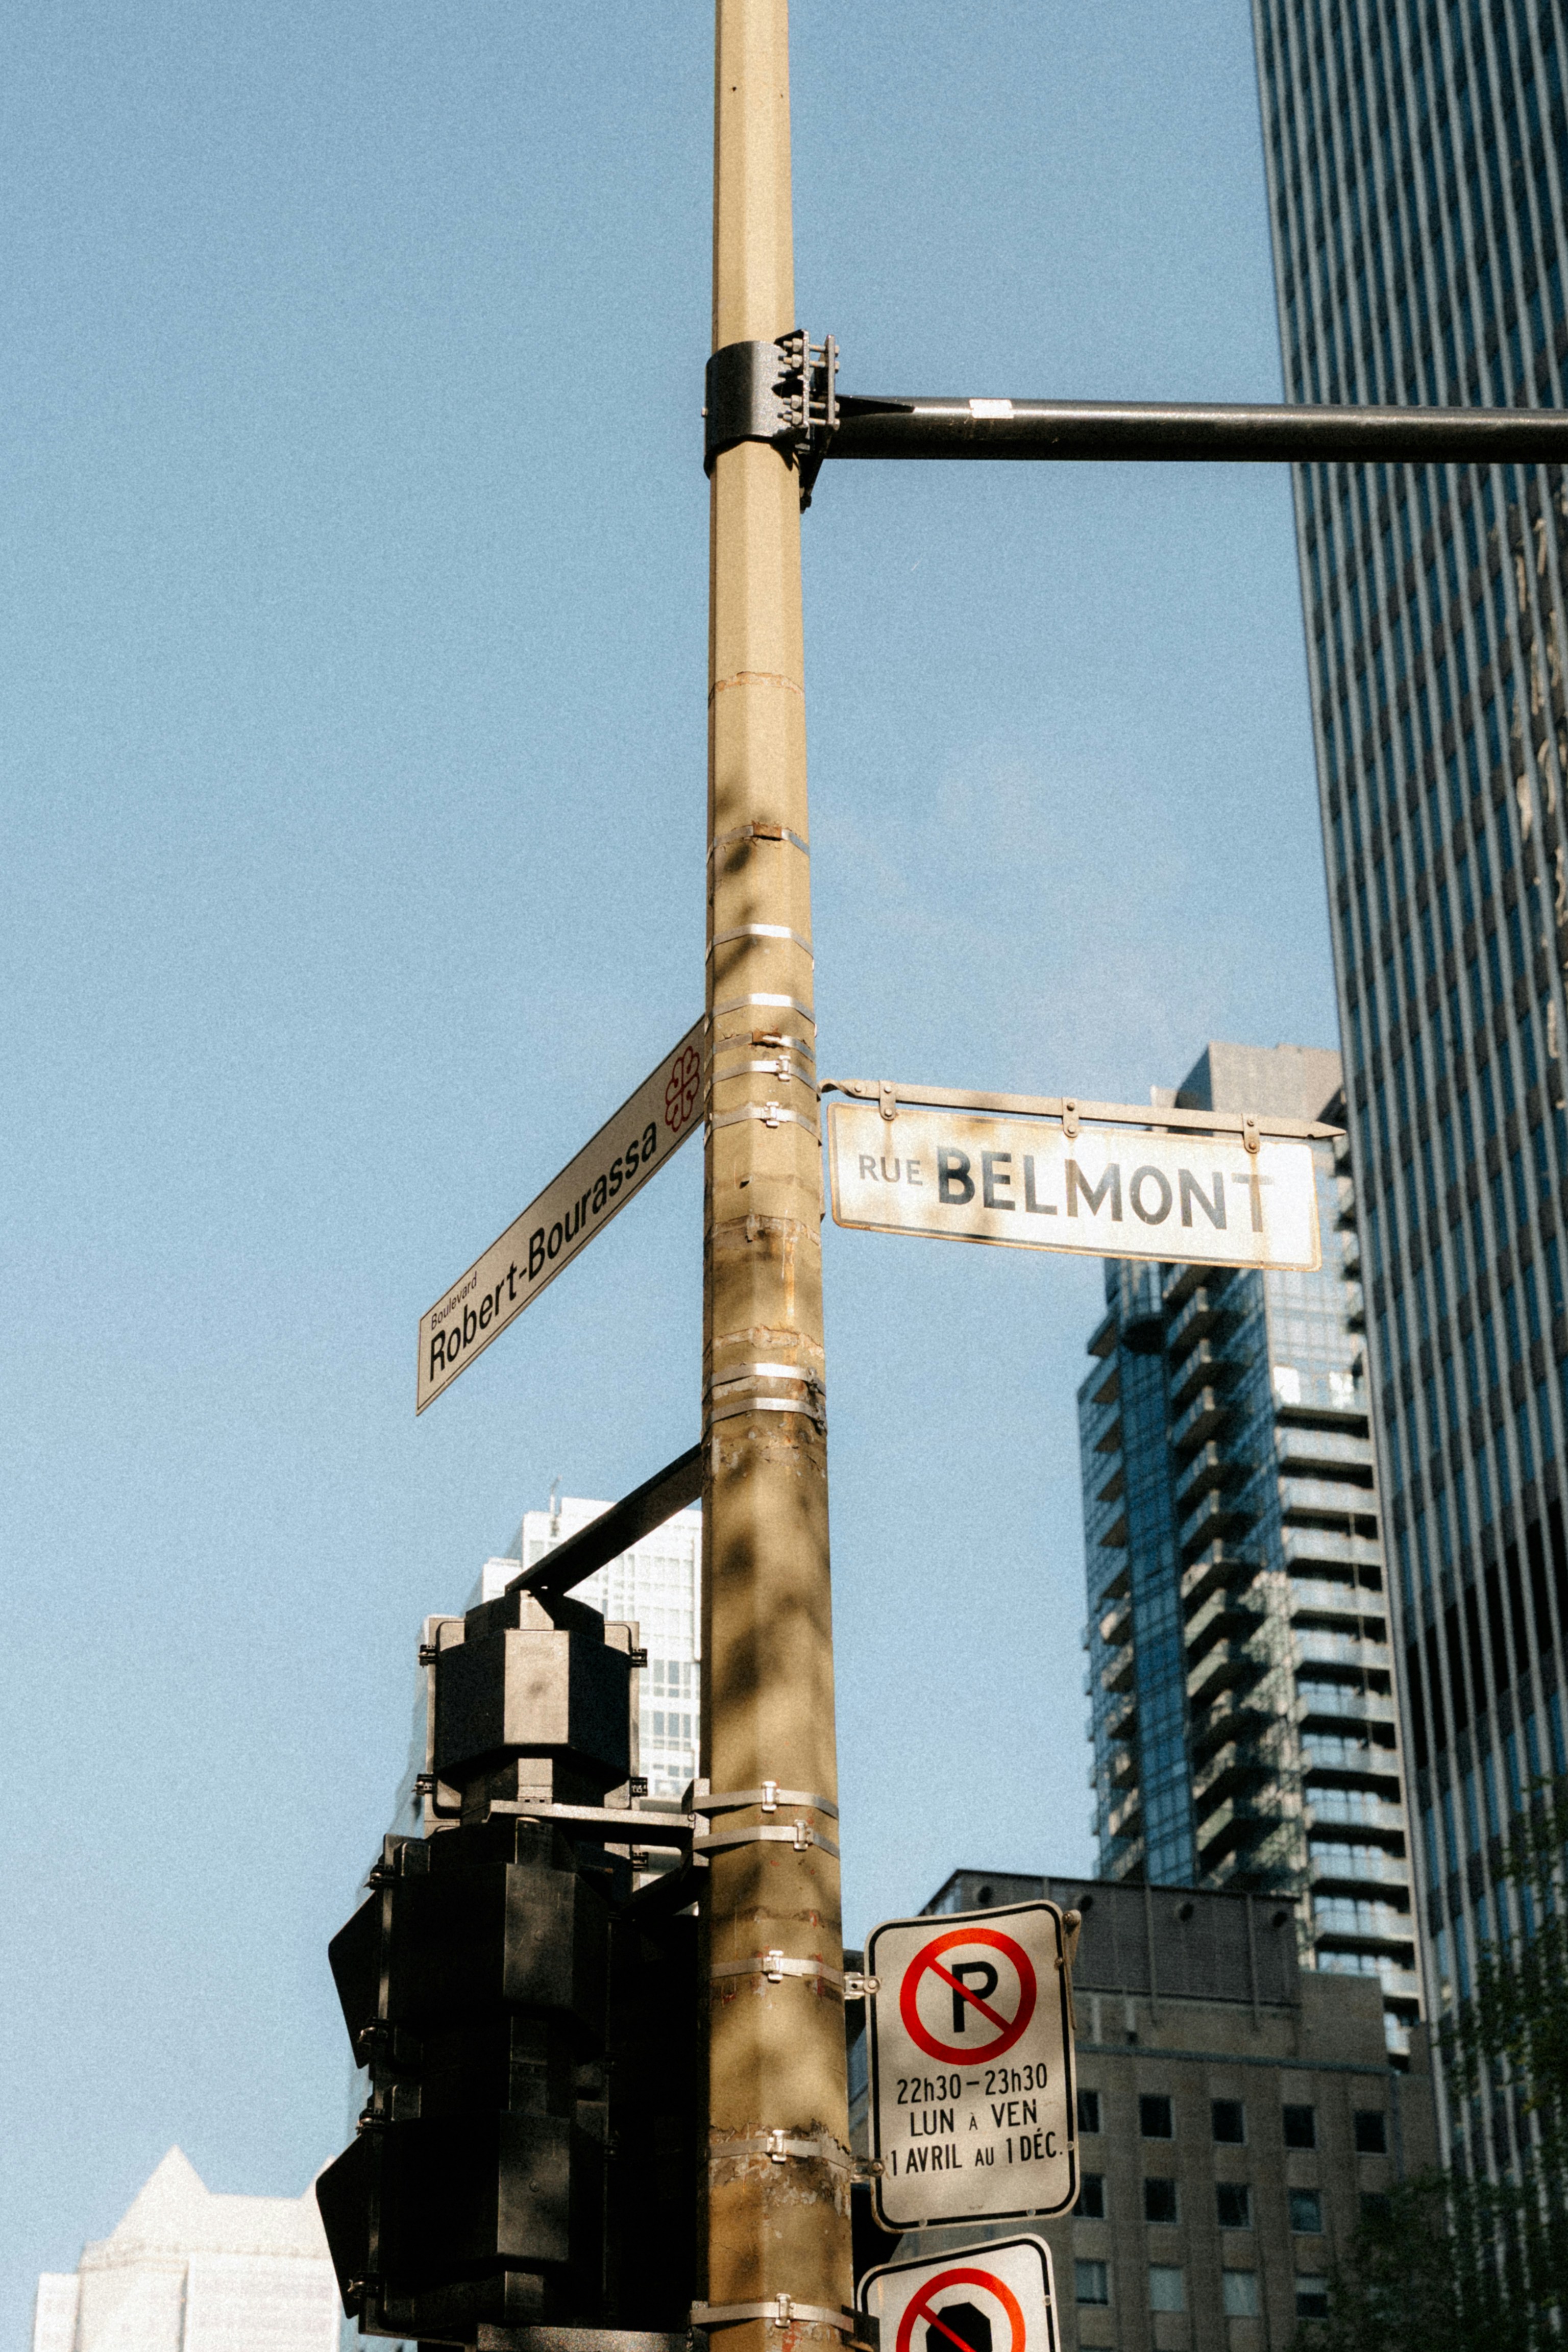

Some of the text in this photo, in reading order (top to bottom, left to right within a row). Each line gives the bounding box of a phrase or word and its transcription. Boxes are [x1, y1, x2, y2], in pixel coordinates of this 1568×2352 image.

[859, 1146, 1275, 1233] RUE BELMONT
[429, 1121, 657, 1383] Robert-Bourassa
[431, 1271, 478, 1331] Boulevard
[951, 1961, 998, 2033] P
[910, 2099, 1037, 2137] LUN À VEN
[891, 2127, 1063, 2176] 1 AVRIL AU 1 DÉC.
